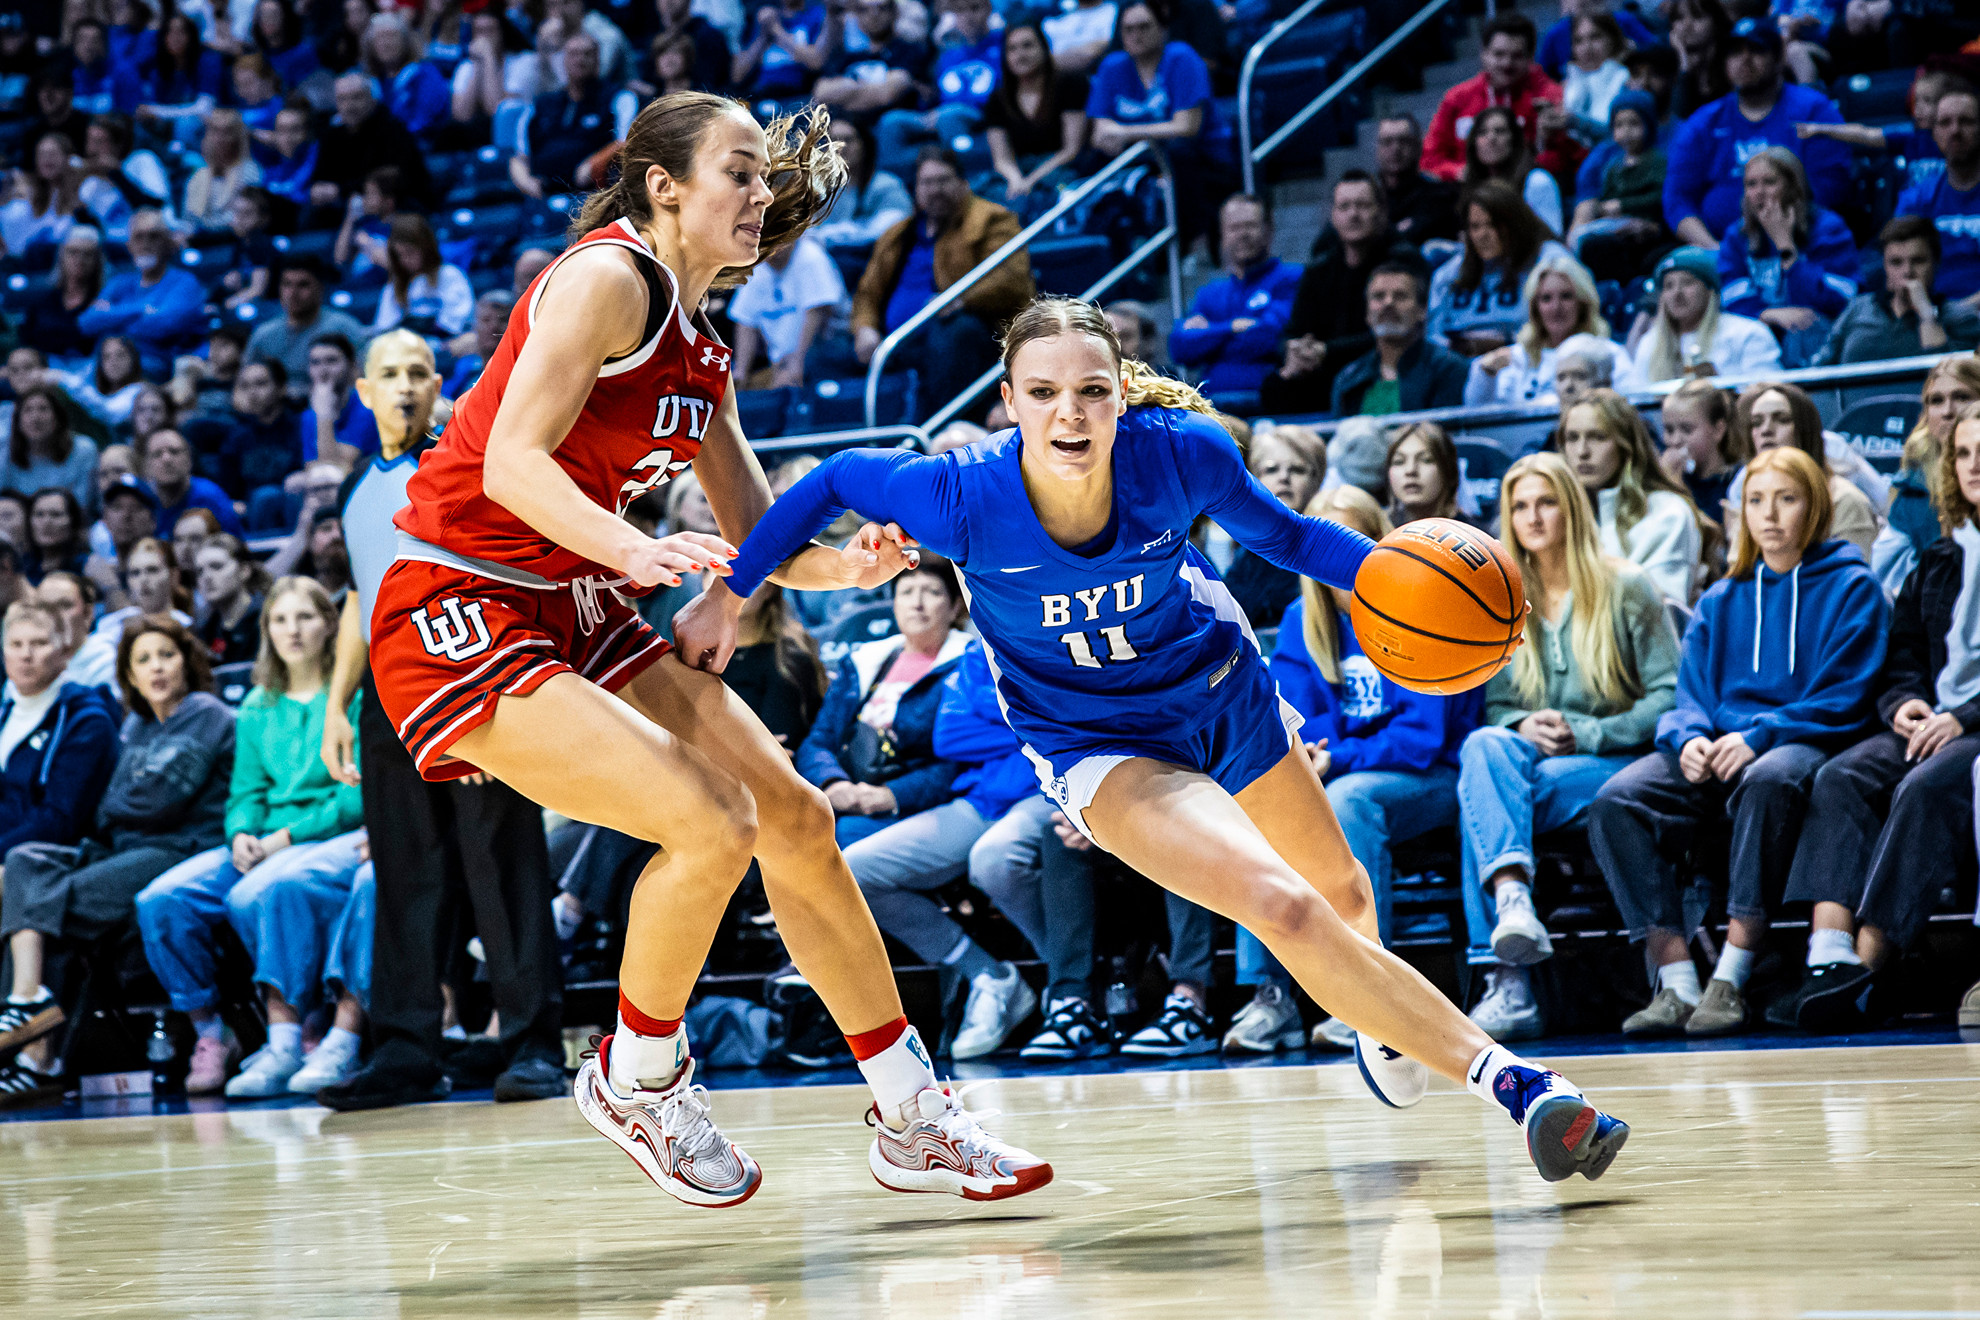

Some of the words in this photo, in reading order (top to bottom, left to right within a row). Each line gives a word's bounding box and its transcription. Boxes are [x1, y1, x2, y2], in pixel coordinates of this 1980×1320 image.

[1401, 522, 1490, 573] ELITE
[1040, 573, 1144, 627] BYU
[1058, 623, 1138, 668] 11
